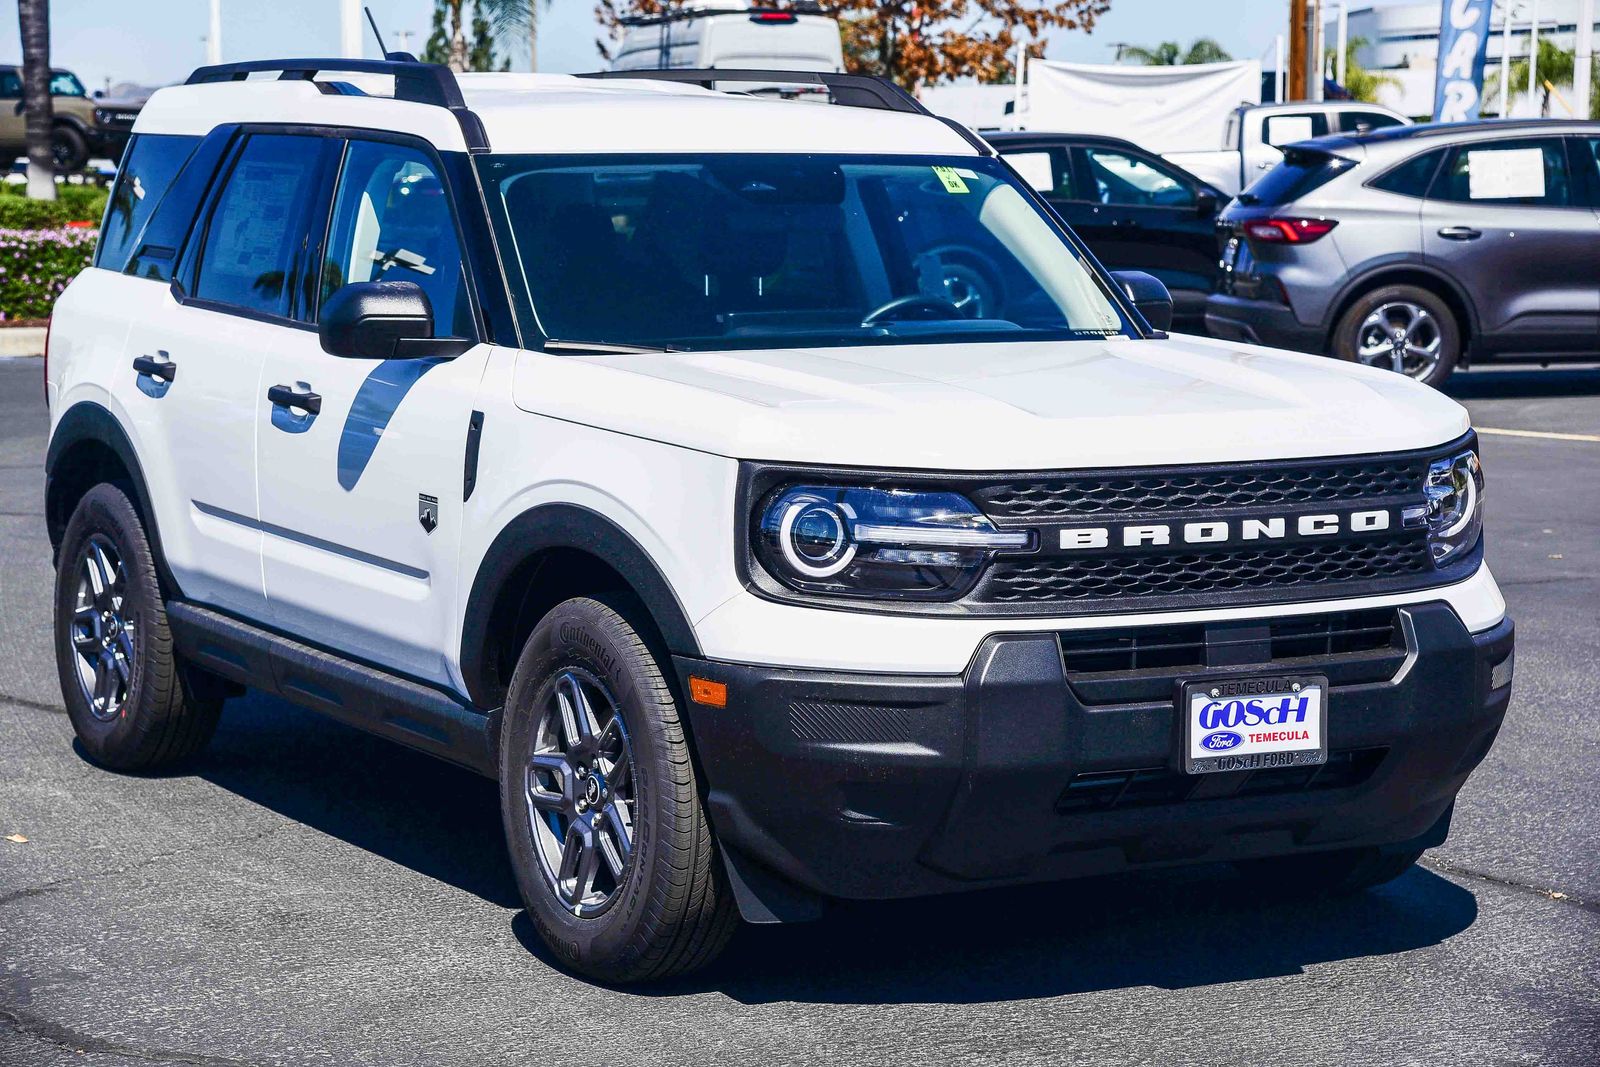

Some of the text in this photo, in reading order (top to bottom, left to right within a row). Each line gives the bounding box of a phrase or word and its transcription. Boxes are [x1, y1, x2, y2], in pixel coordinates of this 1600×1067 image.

[1059, 510, 1390, 549] BRONCO
[560, 621, 616, 672] Continental
[1220, 679, 1291, 695] TEMECULA
[1208, 734, 1235, 749] Ford
[1249, 731, 1309, 743] TEMECULA
[1263, 753, 1294, 767] FORD
